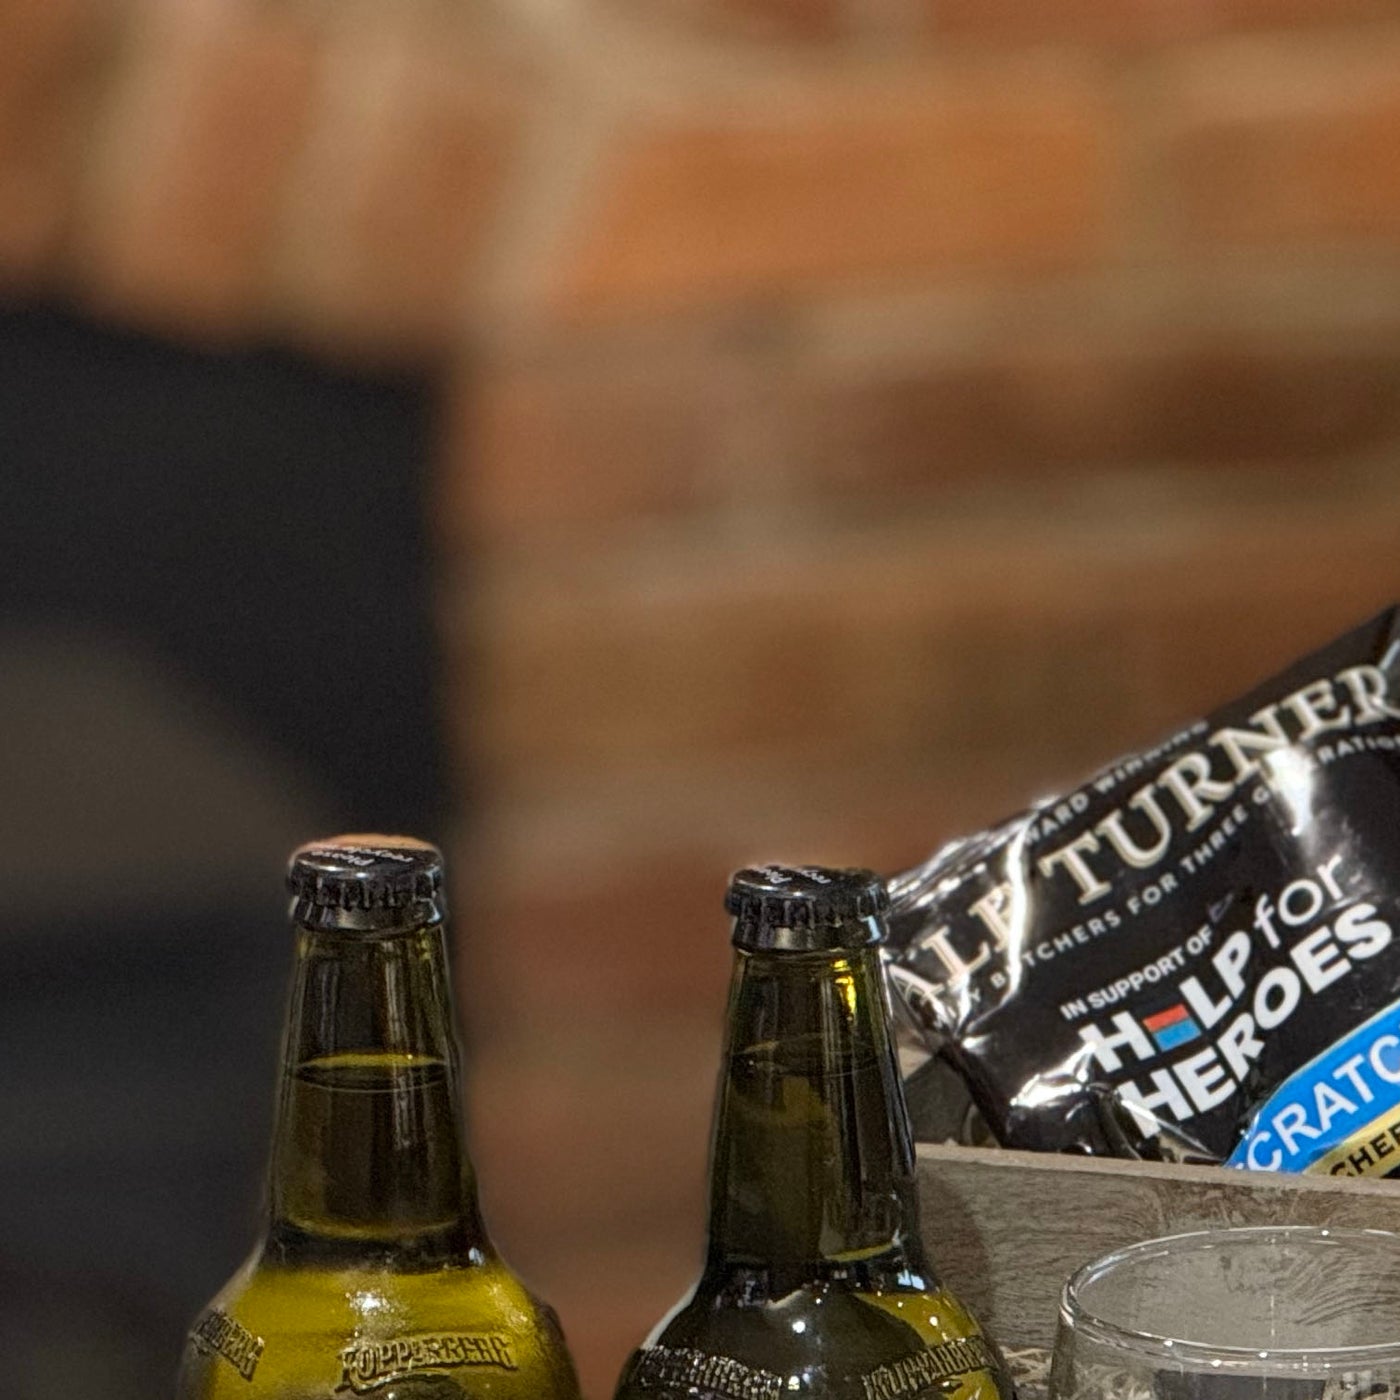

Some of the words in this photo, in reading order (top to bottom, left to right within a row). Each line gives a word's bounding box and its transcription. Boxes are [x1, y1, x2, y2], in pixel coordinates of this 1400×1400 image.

[1024, 792, 1089, 845] WARD
[989, 911, 1121, 989] BTCHERS
[1126, 873, 1179, 915] FOR
[1180, 804, 1248, 874] THREE
[1253, 853, 1342, 949] for
[1060, 1001, 1088, 1021] IN
[1086, 945, 1186, 1009] SUPPORT
[1185, 925, 1215, 957] OF
[1117, 903, 1393, 1140] HEROES
